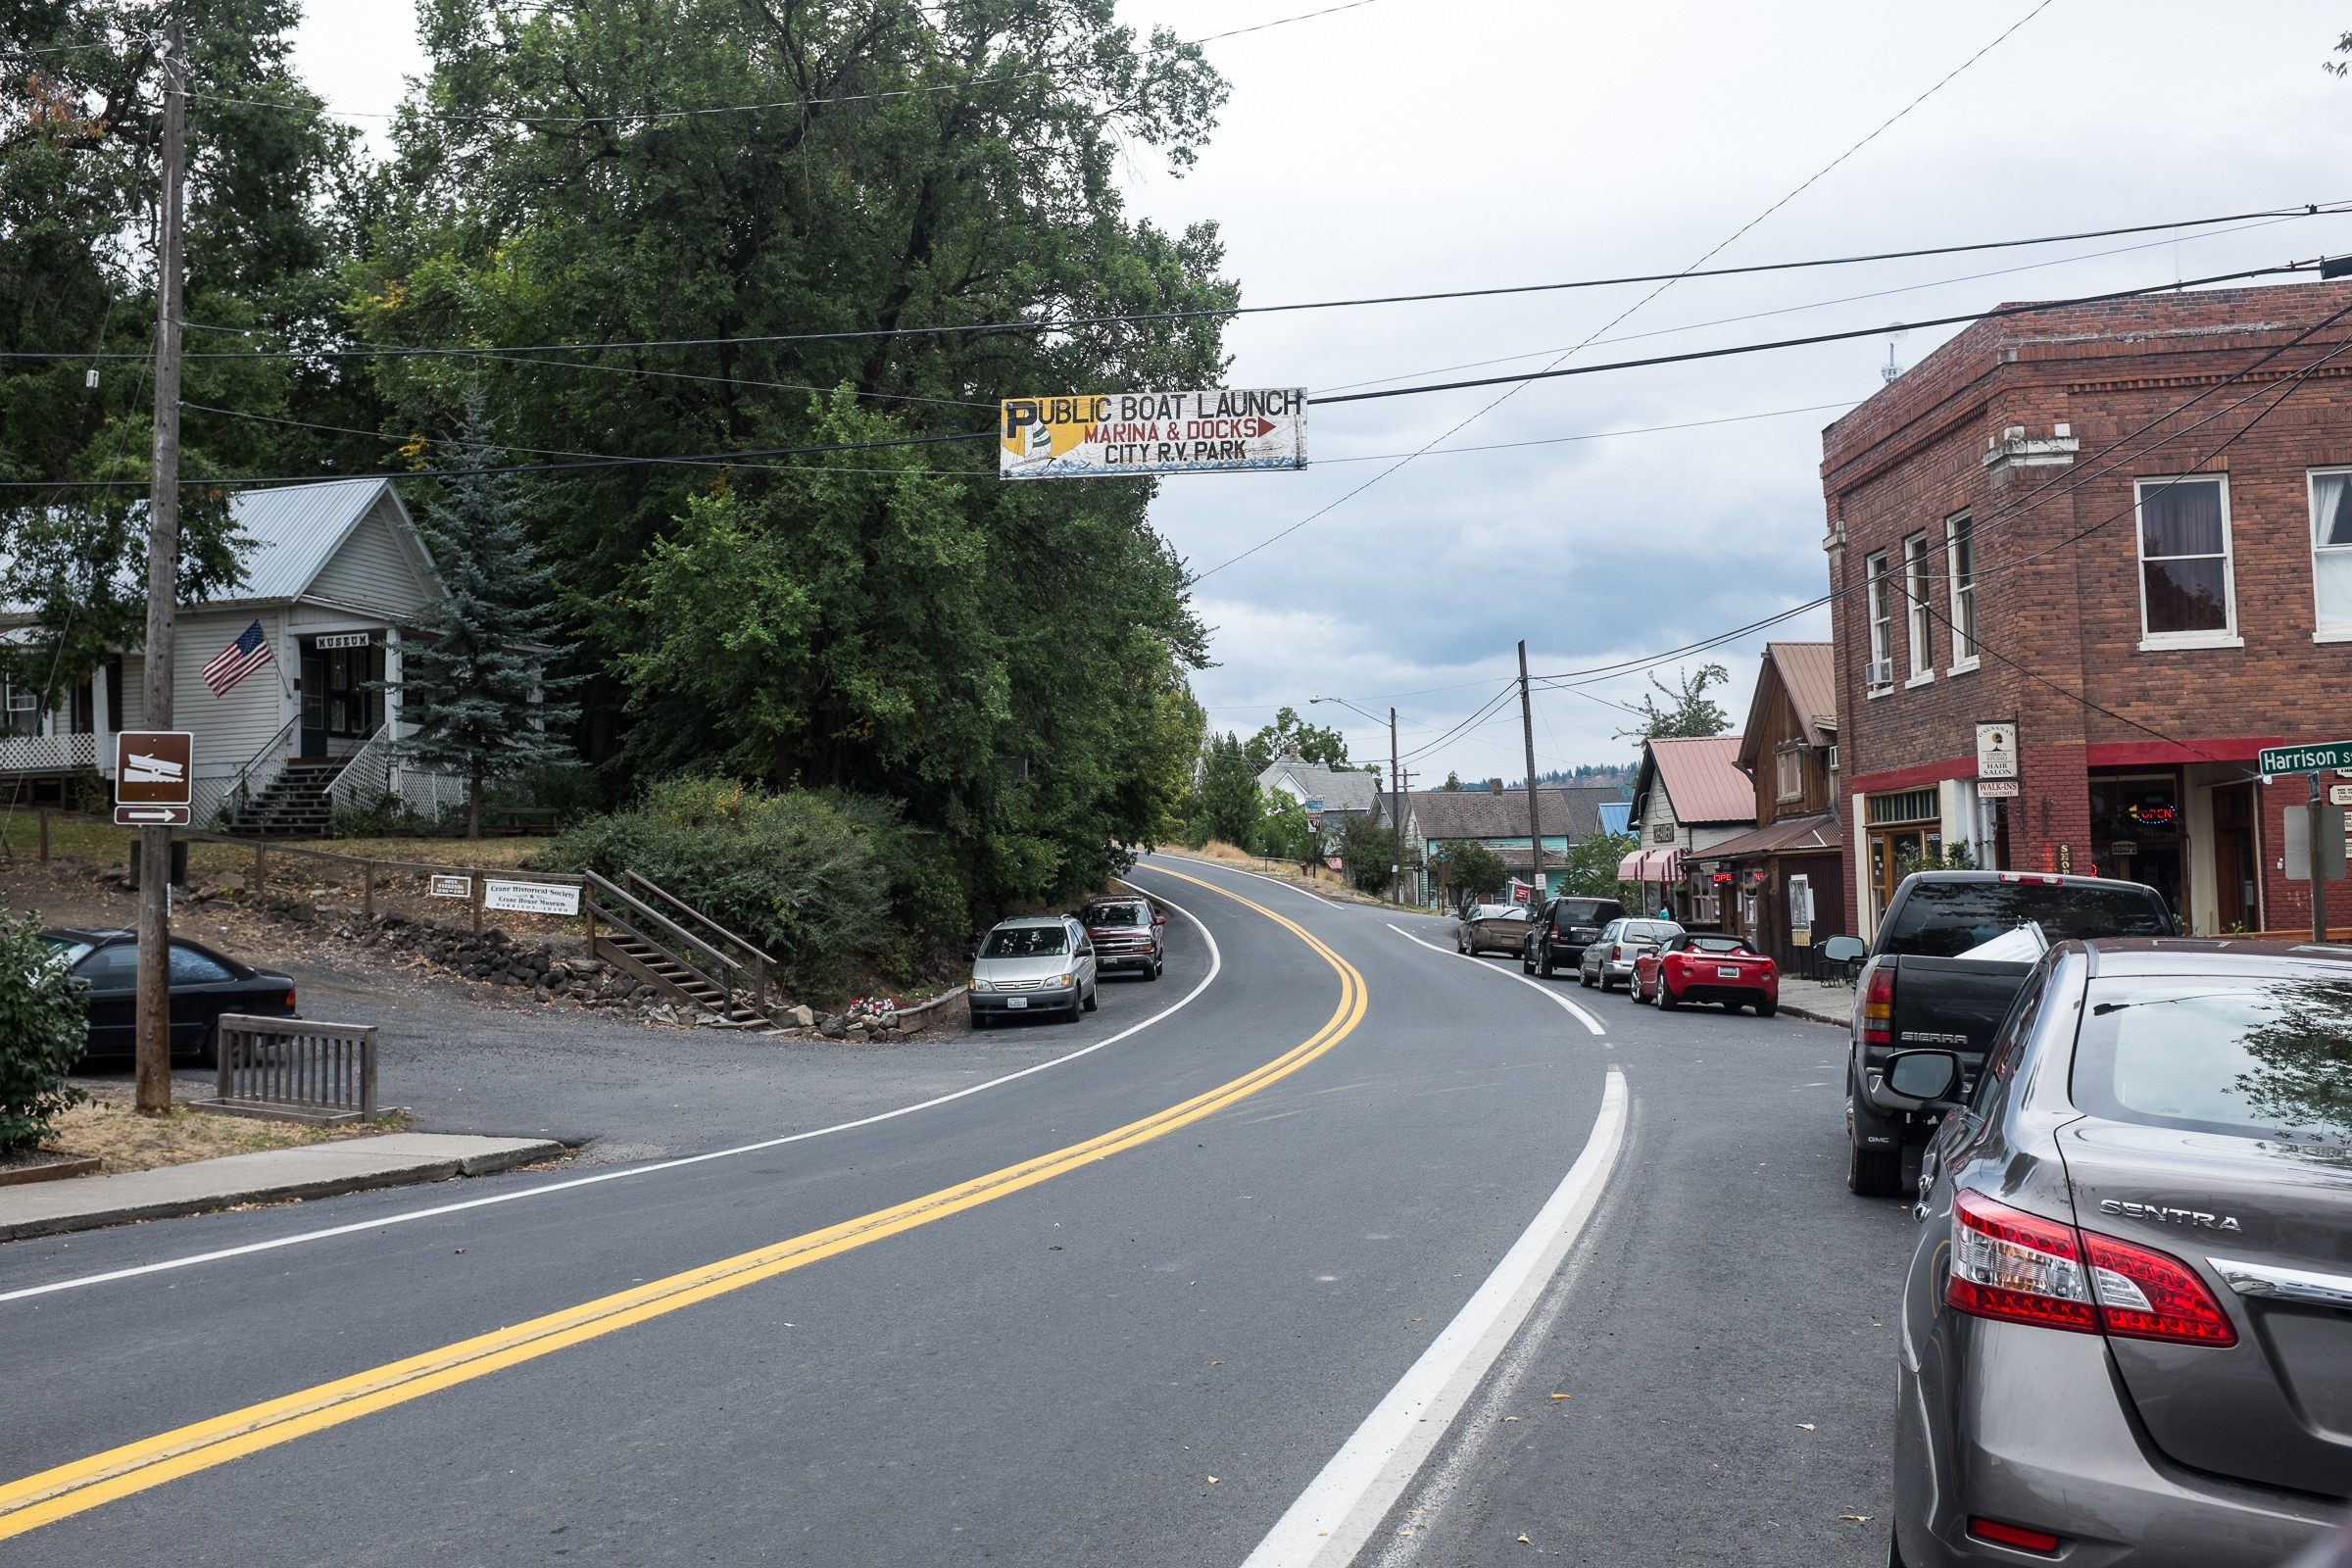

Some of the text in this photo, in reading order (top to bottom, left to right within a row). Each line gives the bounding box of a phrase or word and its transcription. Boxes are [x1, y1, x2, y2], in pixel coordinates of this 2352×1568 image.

[1007, 390, 1300, 438] PUBLIC BOAT LAUNCH
[1084, 418, 1257, 444] MARINA & DOCKS
[1105, 440, 1246, 465] CITY R.V. PARK
[318, 635, 367, 648] MUSEUM
[2264, 750, 2352, 770] Harrison S
[1980, 782, 2017, 791] WALK-INS
[2112, 844, 2137, 854] SHOPS
[550, 889, 575, 899] Society
[1901, 1032, 1968, 1044] SIERRA
[2099, 1200, 2244, 1234] SENTRA
